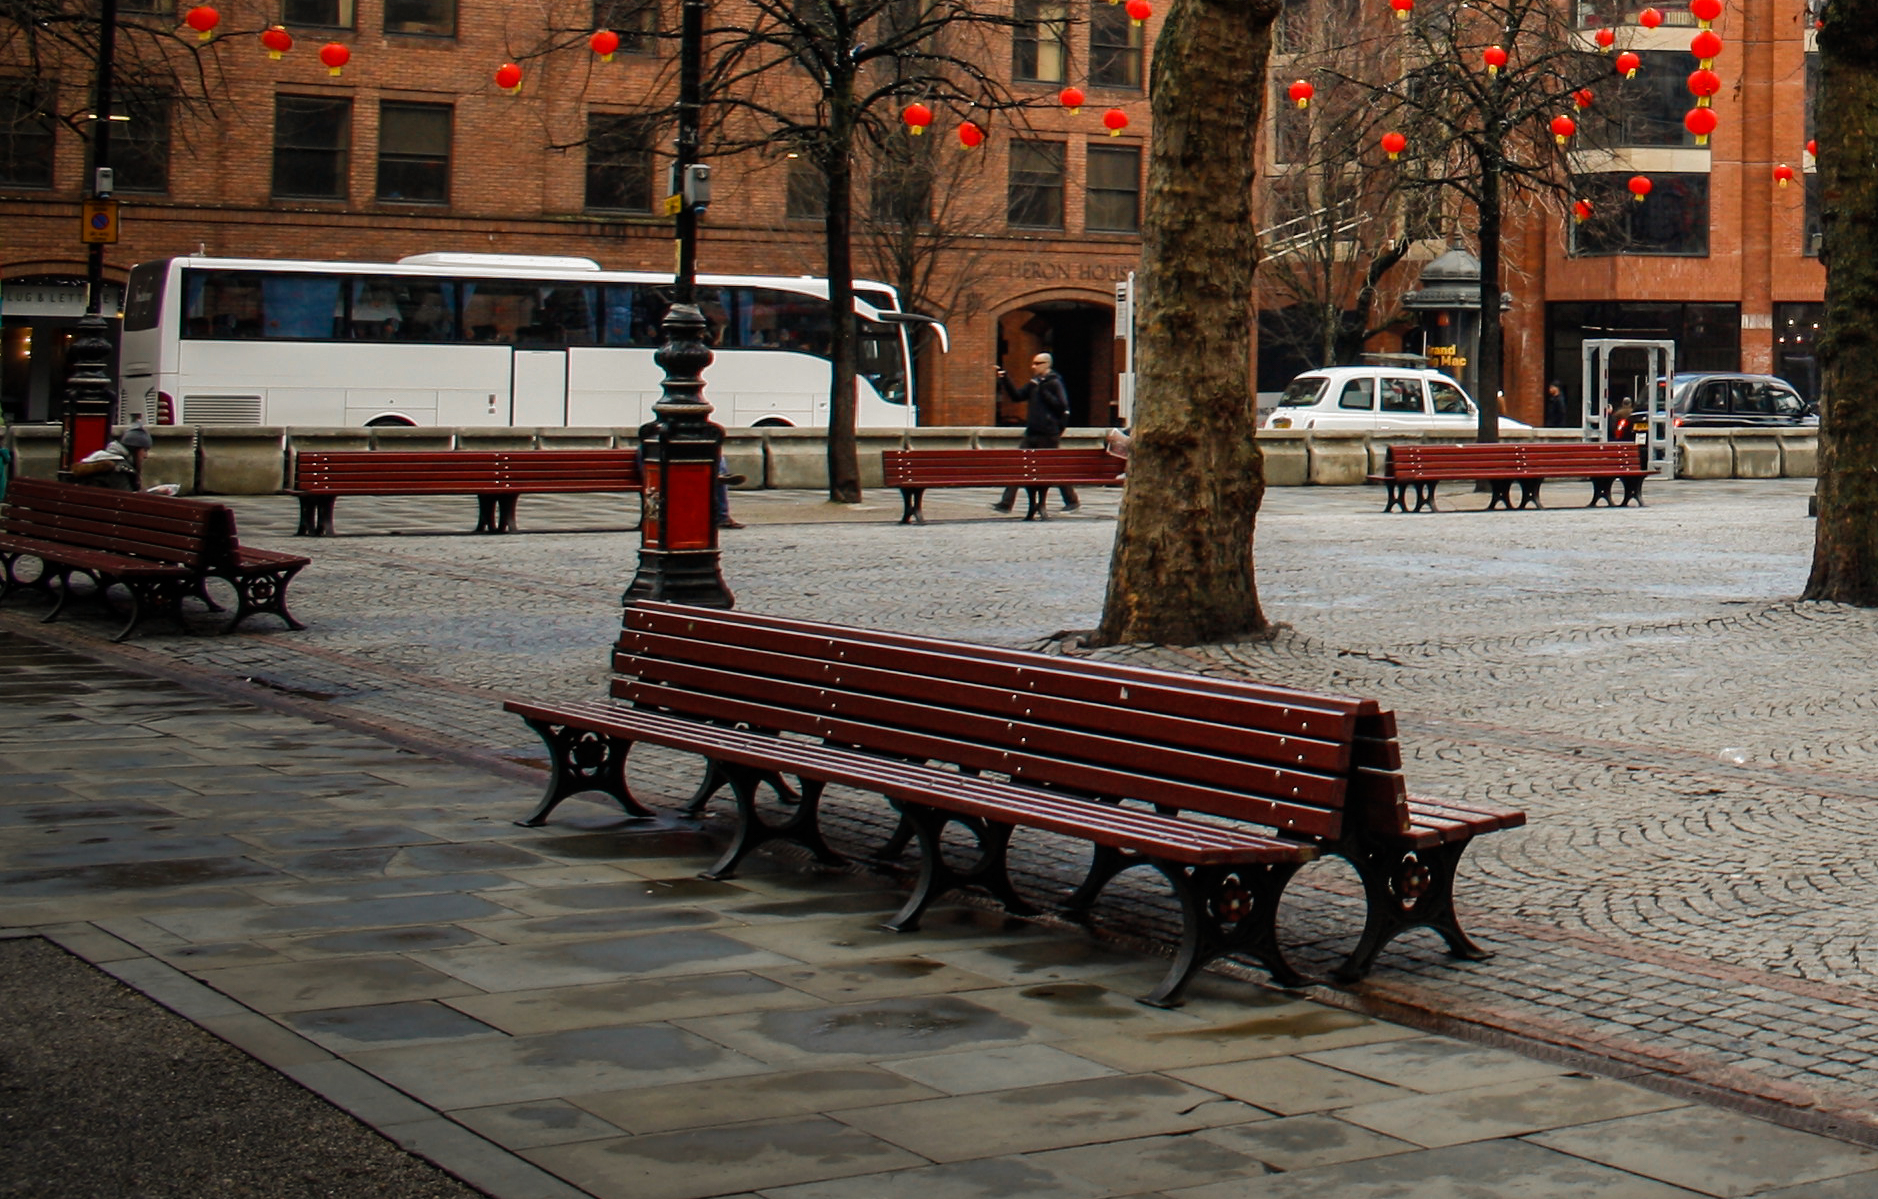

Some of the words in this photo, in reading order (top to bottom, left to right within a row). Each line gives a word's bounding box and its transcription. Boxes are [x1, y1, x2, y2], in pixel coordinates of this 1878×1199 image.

[1079, 263, 1136, 282] HOUS
[0, 292, 32, 303] LUG
[37, 292, 44, 303] &
[50, 293, 110, 304] LETTE
[1441, 355, 1467, 367] Mac
